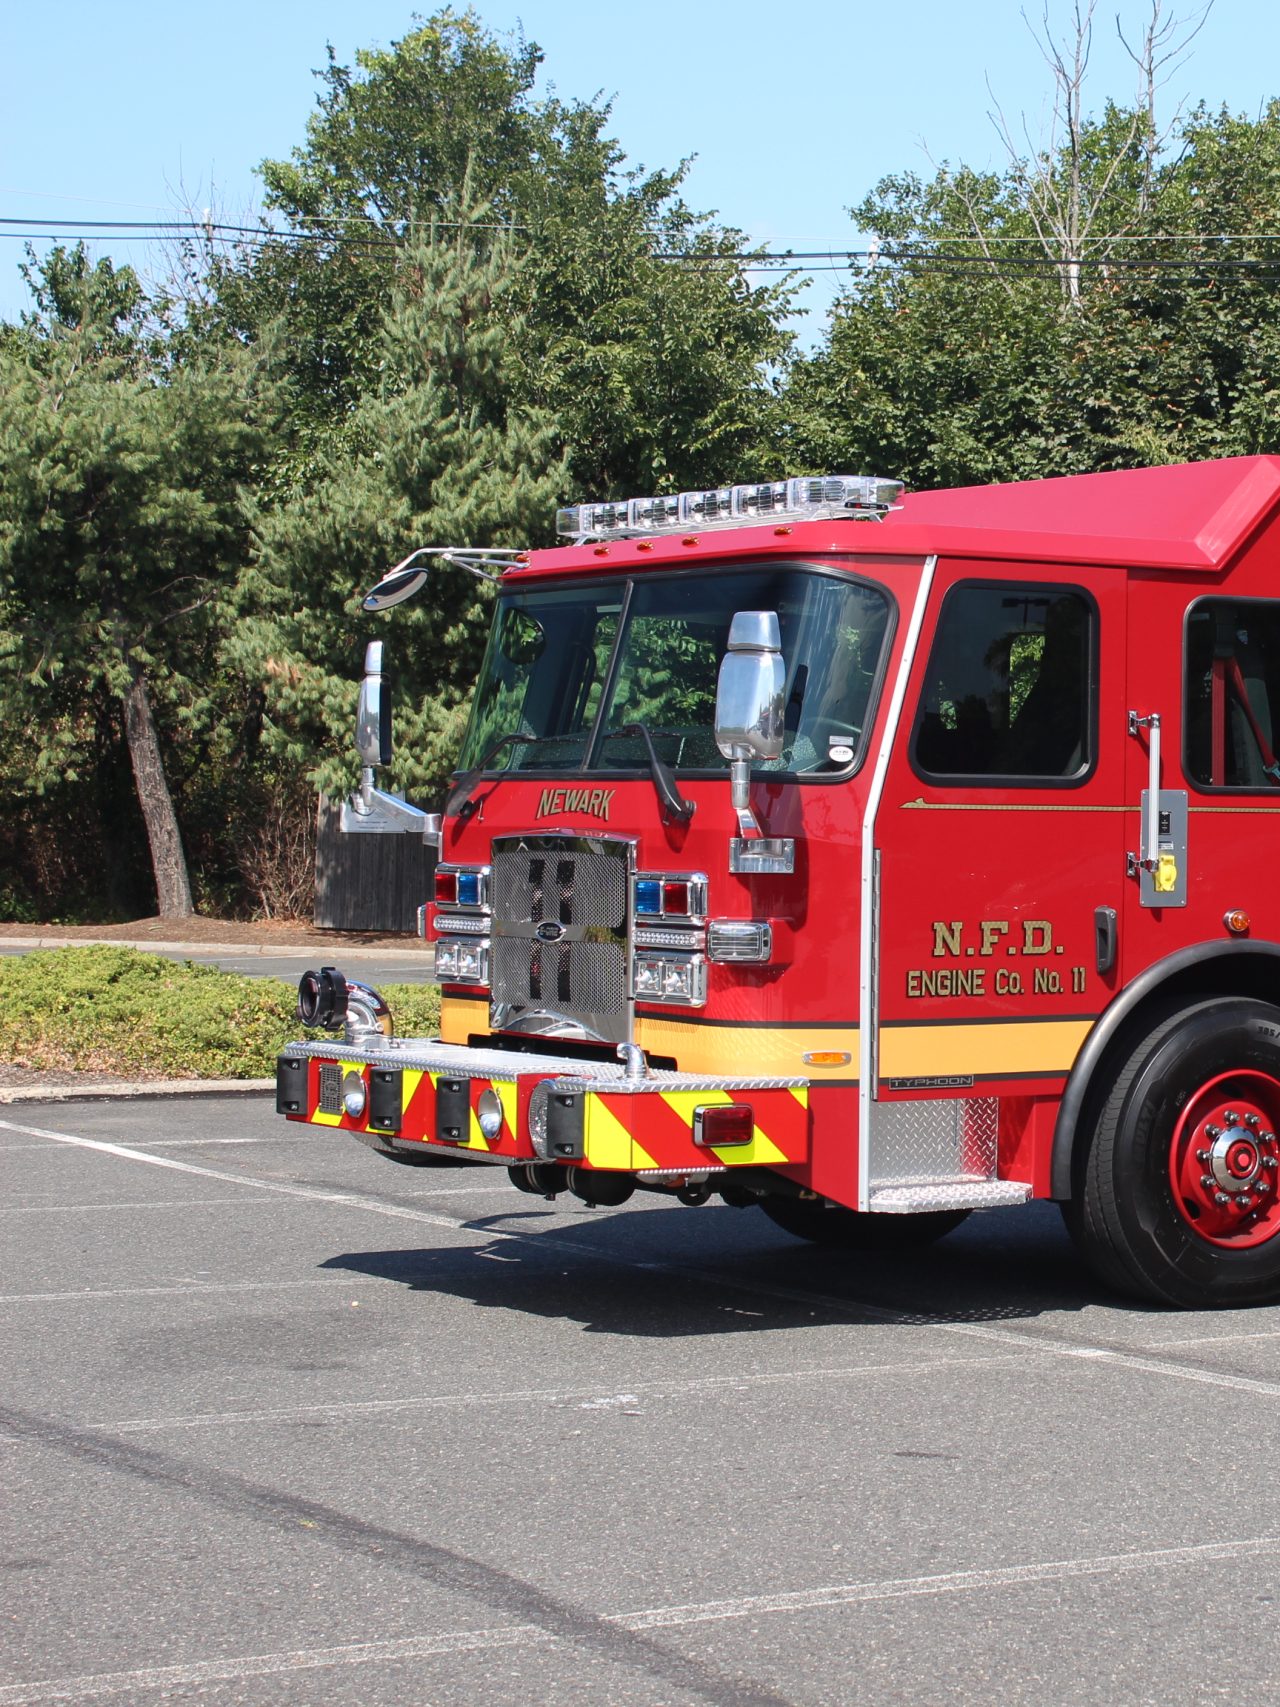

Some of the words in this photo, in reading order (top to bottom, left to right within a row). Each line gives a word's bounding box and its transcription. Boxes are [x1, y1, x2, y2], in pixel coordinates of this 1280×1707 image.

[536, 788, 616, 821] NEWARK
[932, 920, 1065, 957] N.F.D.
[907, 969, 987, 998] ENGINE
[995, 968, 1025, 995] Co.
[1033, 967, 1065, 994] No.
[1072, 967, 1087, 993] 11
[892, 1077, 971, 1087] TYPHOON
